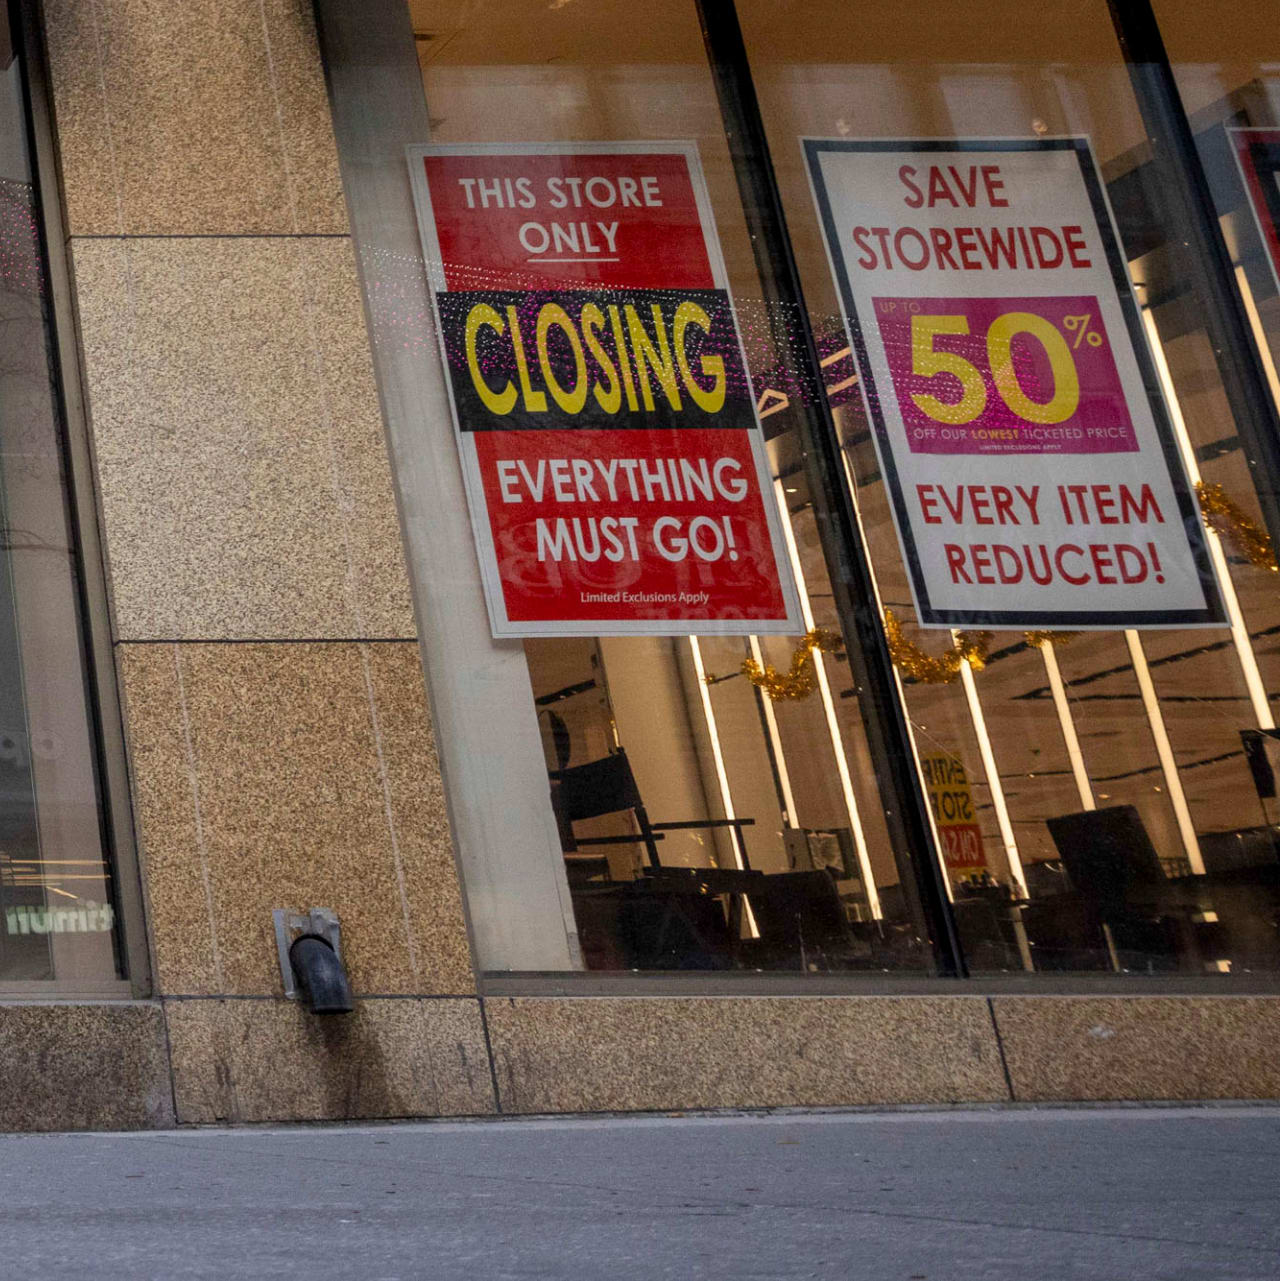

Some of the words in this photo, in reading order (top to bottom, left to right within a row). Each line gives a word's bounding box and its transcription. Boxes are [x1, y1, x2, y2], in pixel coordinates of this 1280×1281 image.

[458, 176, 537, 209] THIS
[547, 176, 663, 208] STORE
[898, 164, 1009, 209] SAVE
[518, 221, 620, 253] ONLY
[852, 225, 1092, 271] STOREWIDE
[880, 301, 899, 313] UP
[902, 301, 921, 313] TO
[464, 301, 727, 416] CLOSING
[910, 312, 1103, 425] 50%
[914, 428, 937, 440] OFF
[940, 428, 967, 440] OUR
[970, 428, 1019, 440] LOWEST
[1023, 428, 1083, 440] TICKETED
[1087, 427, 1128, 438] PRICE
[496, 457, 748, 503] EVERYTHING
[915, 484, 1040, 525] EVERY
[1056, 484, 1165, 525] ITEM
[536, 516, 640, 562] MUST
[652, 515, 739, 563] GO!
[943, 541, 1166, 586] REDUCED!
[580, 591, 621, 603] Limited
[622, 591, 677, 603] Exclusions
[678, 591, 710, 605] Apply
